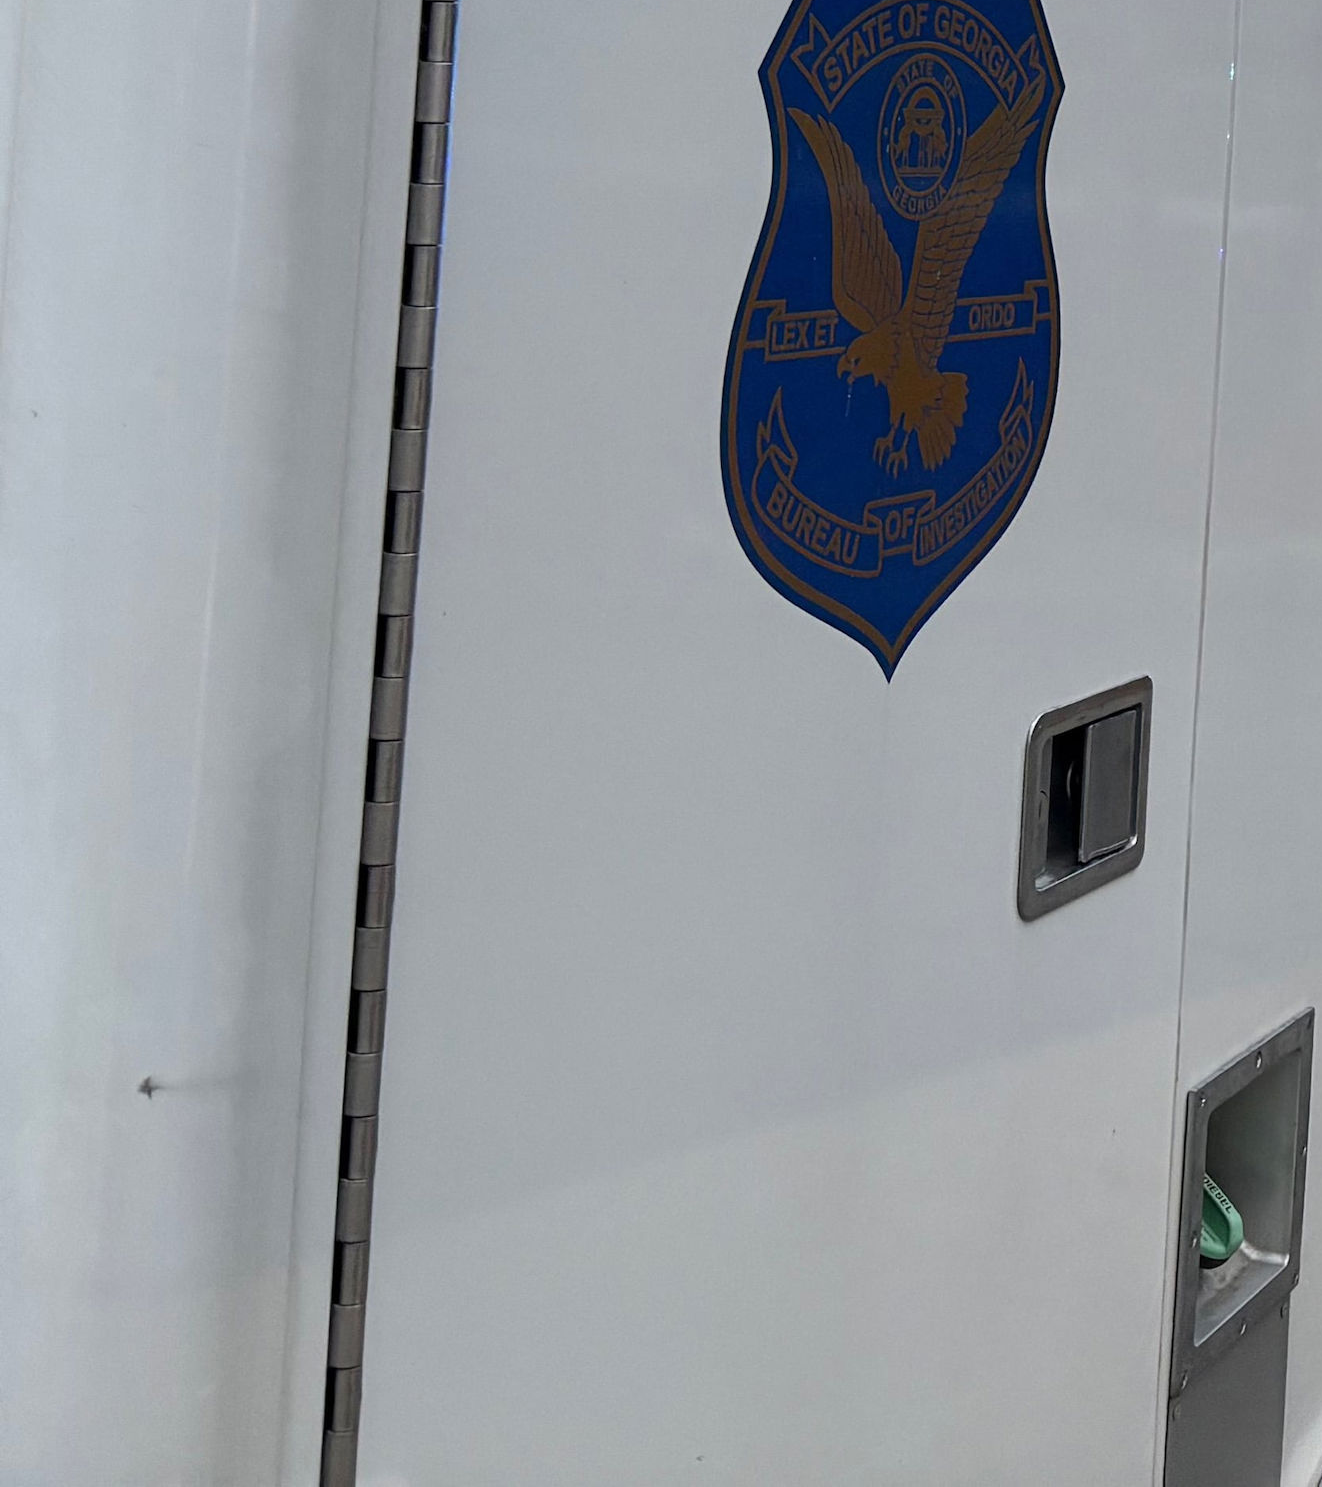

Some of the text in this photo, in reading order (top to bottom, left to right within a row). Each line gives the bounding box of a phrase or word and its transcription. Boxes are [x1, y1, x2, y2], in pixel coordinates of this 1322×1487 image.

[824, 3, 1019, 101] STATE OF GEORGIA
[896, 60, 958, 98] STATE OF
[892, 185, 948, 213] GEORGIA
[968, 302, 1015, 331] ORDO
[771, 318, 839, 351] LEX ET
[766, 429, 1028, 565] BUREAU OF INVESTIGATION
